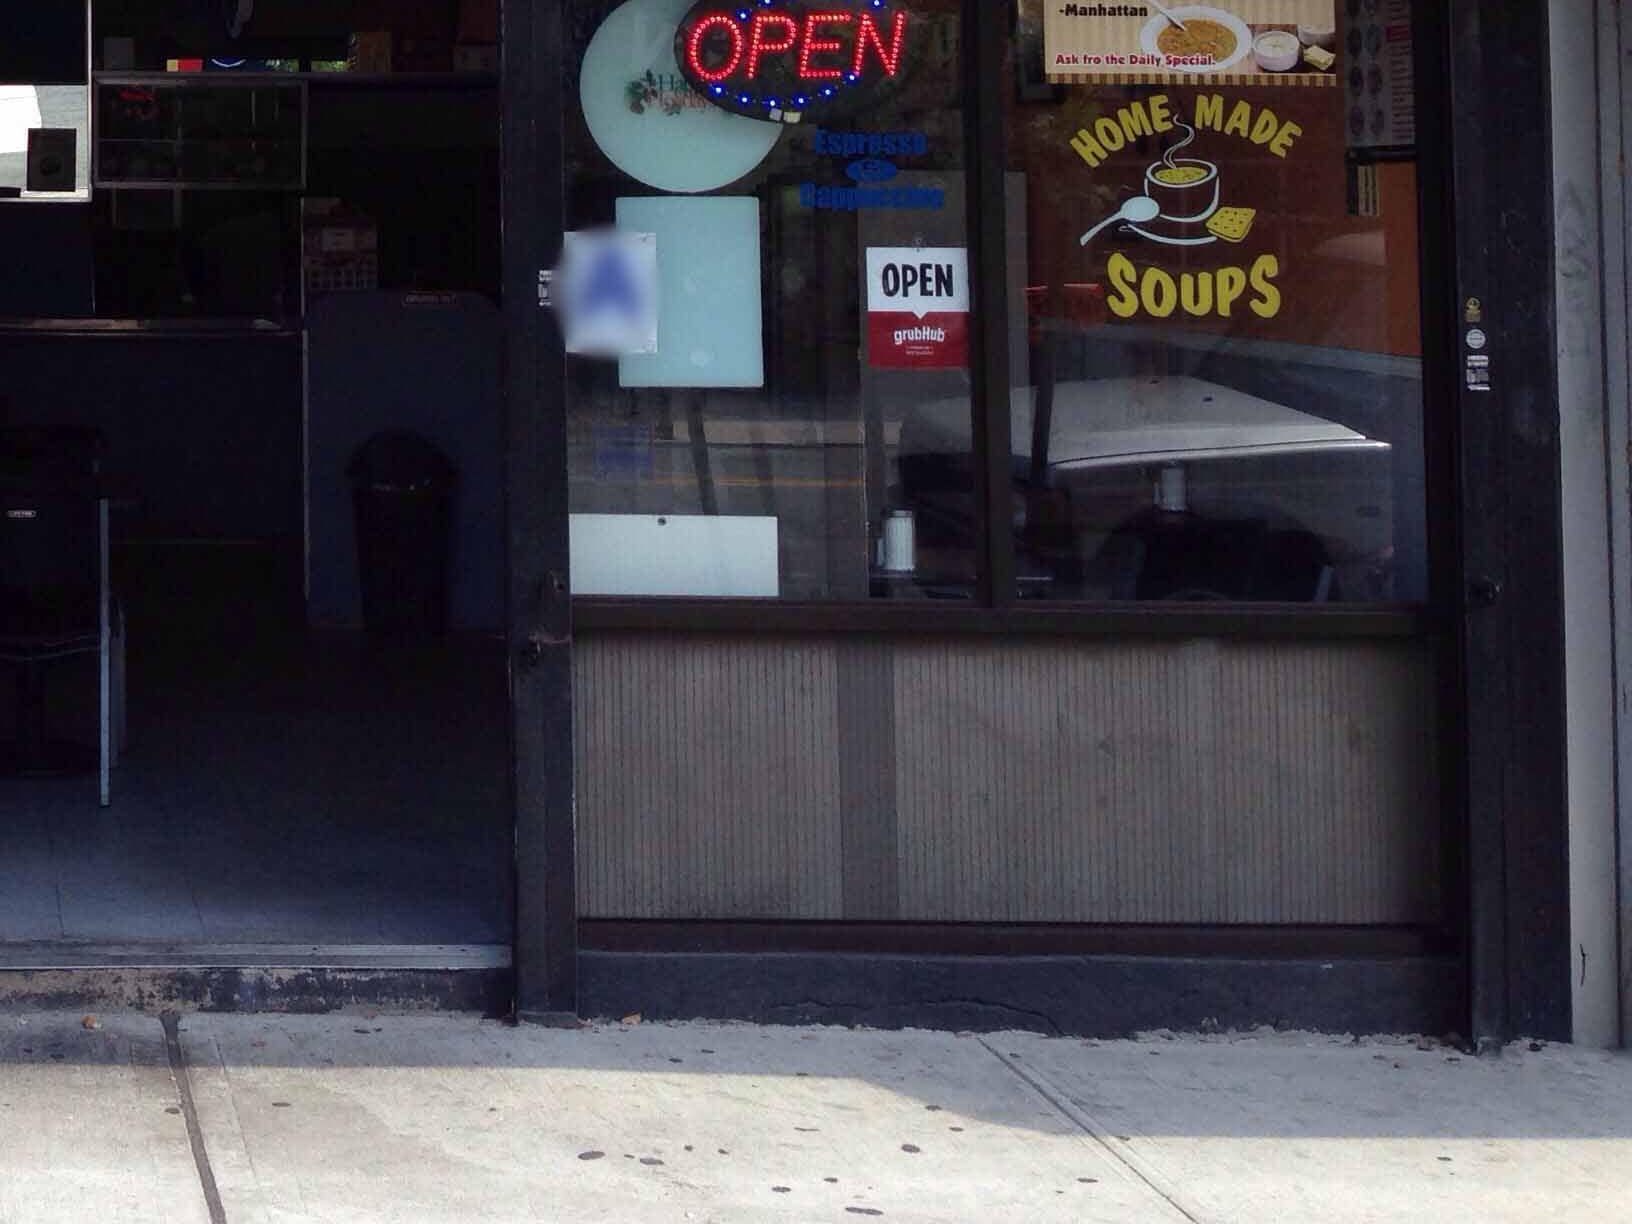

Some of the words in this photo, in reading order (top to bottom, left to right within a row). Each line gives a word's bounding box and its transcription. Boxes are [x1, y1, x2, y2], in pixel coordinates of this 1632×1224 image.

[687, 10, 906, 82] OPEN
[1056, 54, 1079, 65] Ask
[1106, 54, 1125, 65] the
[1129, 54, 1161, 67] Daily
[1069, 94, 1174, 168] HOME
[1194, 93, 1303, 159] MADE
[881, 262, 954, 297] OPEN
[1107, 252, 1281, 318] SOUPS
